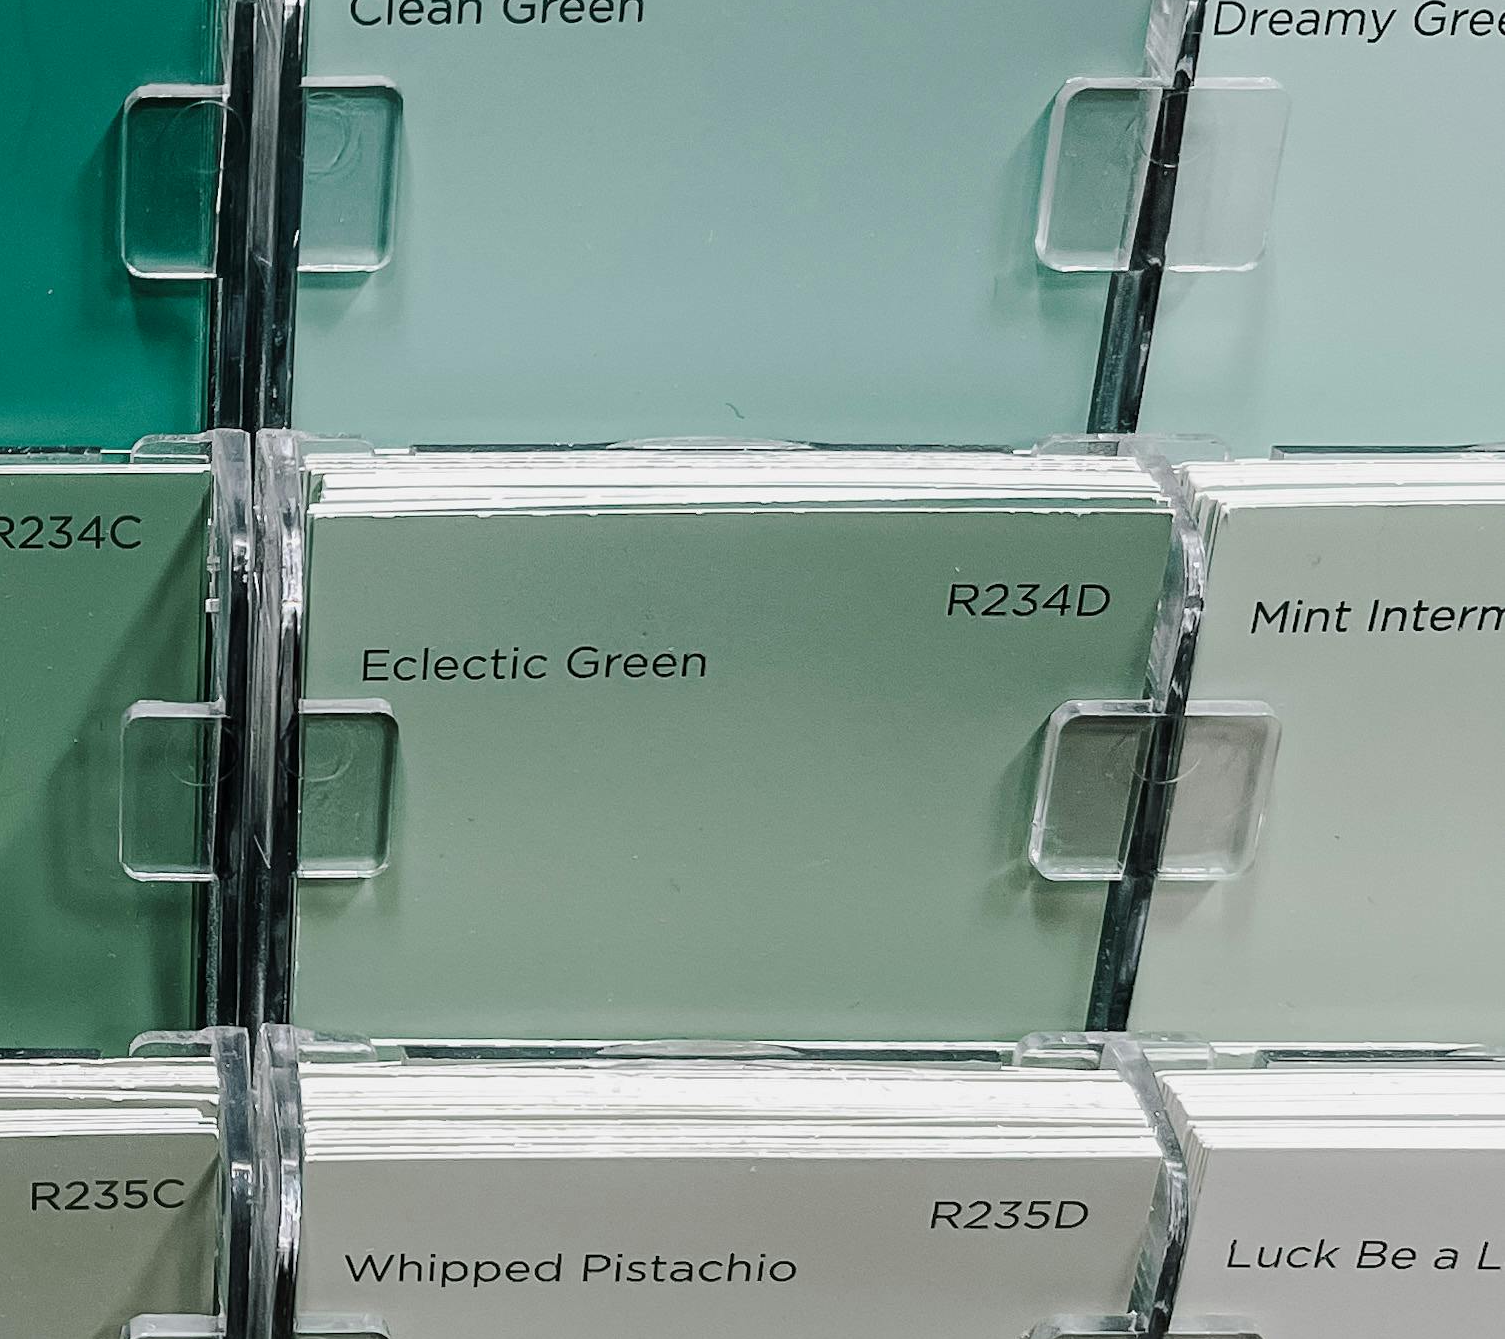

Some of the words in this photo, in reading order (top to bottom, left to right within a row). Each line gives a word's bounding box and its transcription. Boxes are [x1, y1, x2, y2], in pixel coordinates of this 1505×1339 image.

[1213, 0, 1397, 44] Dreamy
[947, 583, 1111, 617] R234D
[1251, 600, 1352, 634] Mint
[362, 647, 548, 682] Eclectic
[567, 646, 707, 679] Green
[31, 1178, 185, 1211] R235C
[930, 1200, 1089, 1230] R235D
[345, 1253, 563, 1288] Whipped
[582, 1252, 797, 1283] Pistachio
[1227, 1238, 1339, 1269] Luck
[1356, 1240, 1417, 1270] Be
[1433, 1247, 1459, 1270] a
[1477, 1241, 1501, 1271] L
